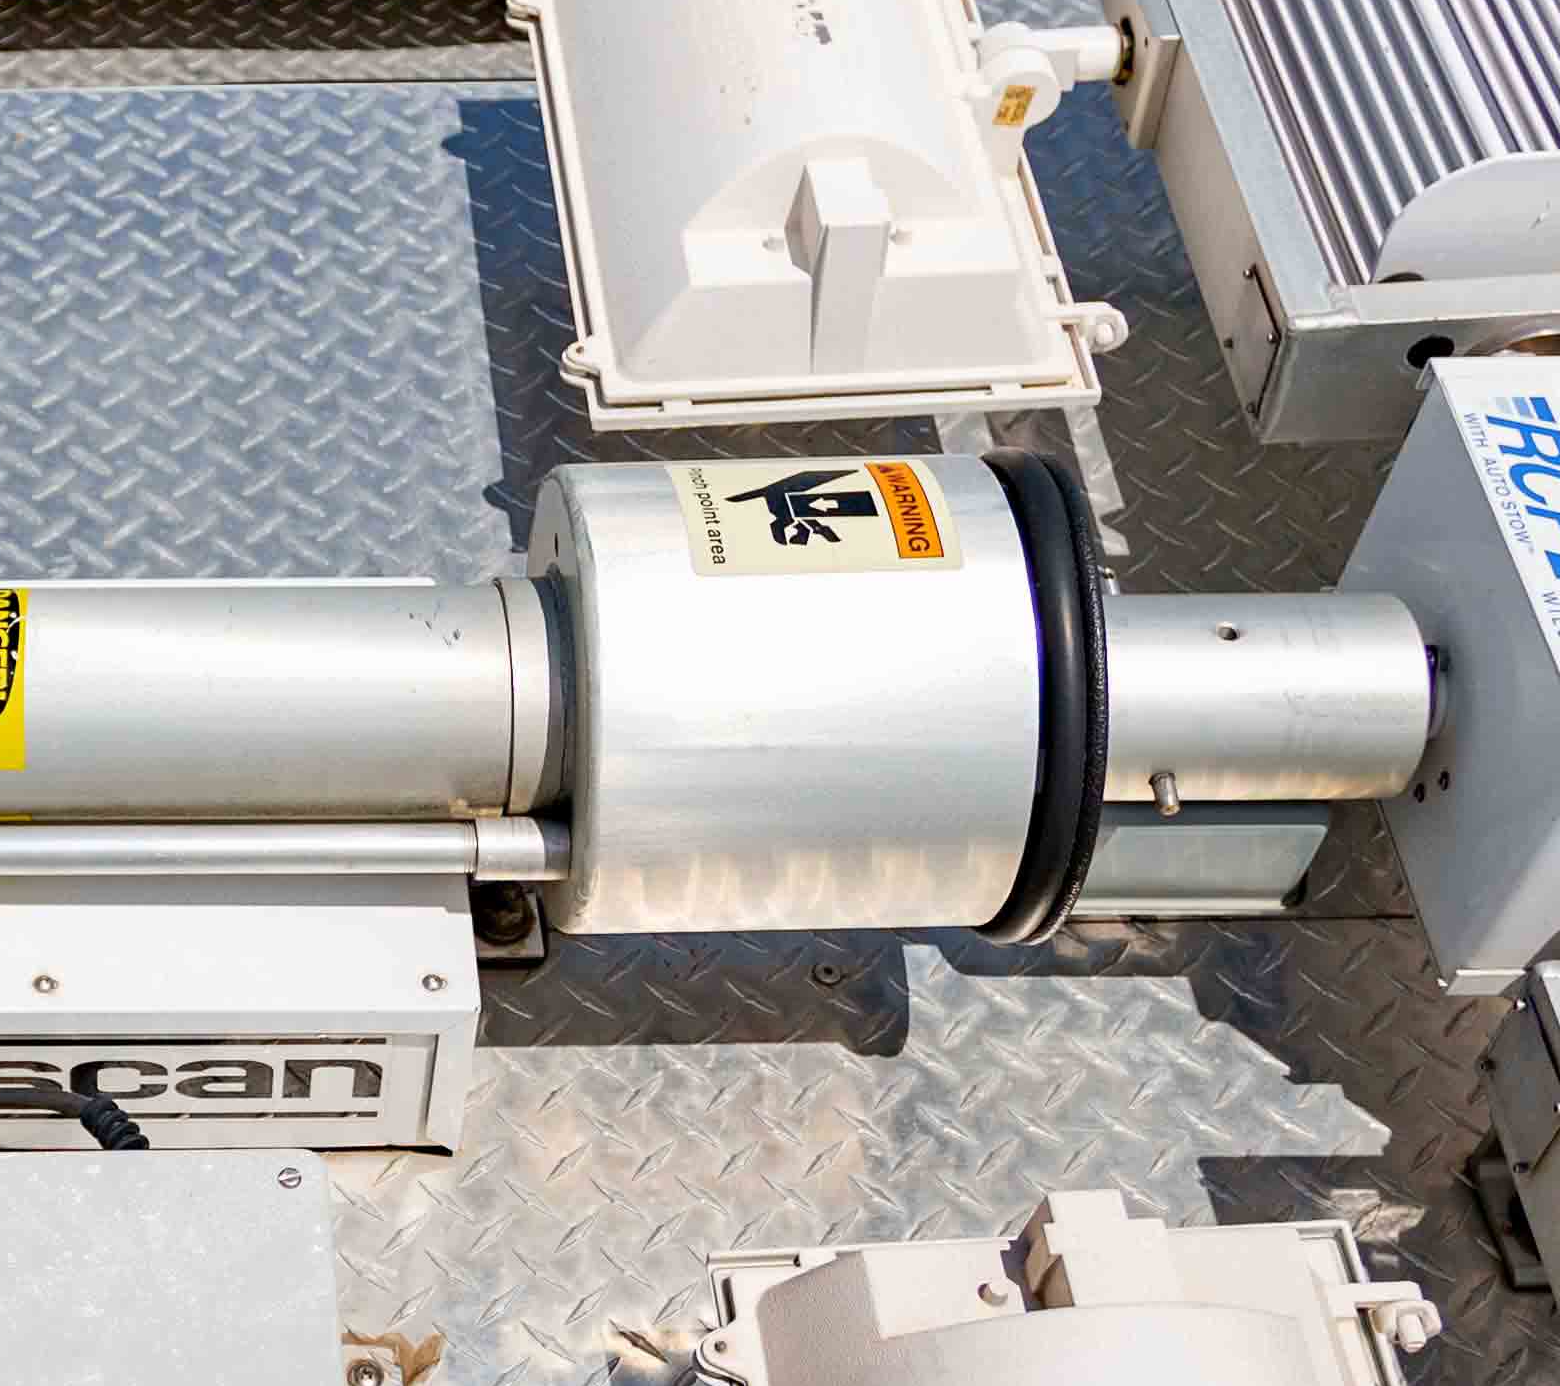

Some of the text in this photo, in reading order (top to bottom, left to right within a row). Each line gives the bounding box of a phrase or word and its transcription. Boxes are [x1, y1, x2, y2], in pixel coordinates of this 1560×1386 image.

[1463, 413, 1489, 448] WITH
[1484, 458, 1509, 497] AUTO
[694, 491, 720, 525] point
[708, 528, 726, 565] area
[887, 472, 930, 552] WARNING
